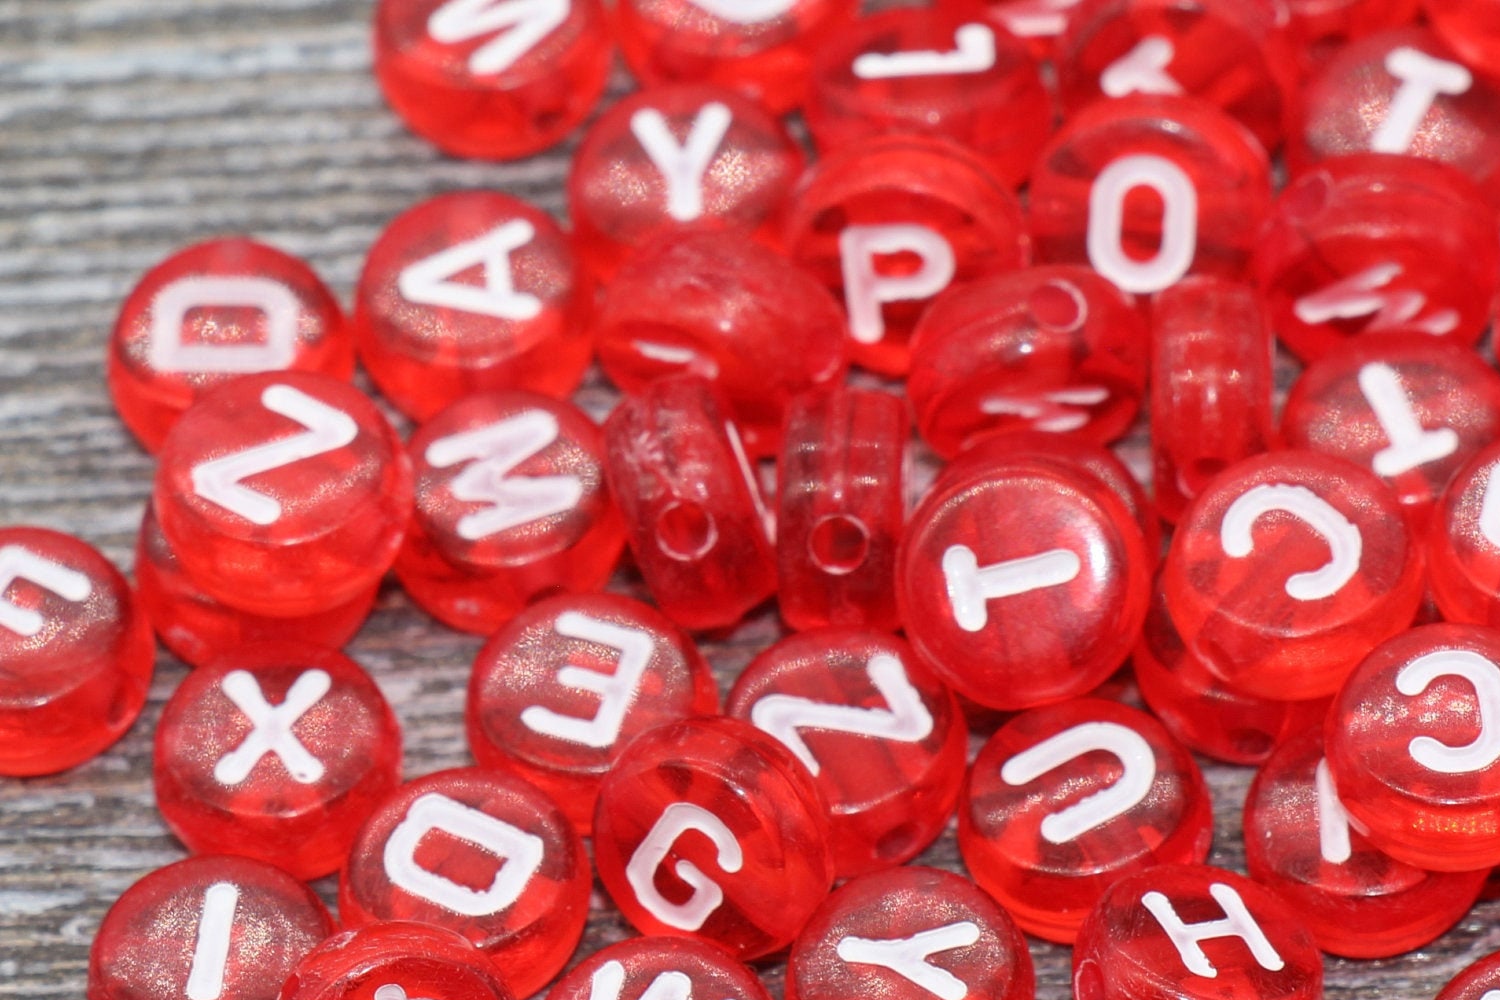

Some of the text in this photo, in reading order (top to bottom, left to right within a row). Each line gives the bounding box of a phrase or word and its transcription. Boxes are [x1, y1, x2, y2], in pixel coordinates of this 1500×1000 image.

[854, 24, 995, 79] L
[1361, 47, 1470, 155] T
[630, 102, 732, 223] Y
[396, 218, 544, 324] A
[1088, 155, 1197, 293] O
[140, 274, 303, 375] D
[841, 226, 954, 343] P
[189, 383, 359, 526] Z
[1358, 362, 1459, 477] T
[941, 544, 1082, 632] T
[1220, 483, 1363, 602] C
[213, 669, 331, 787] X
[520, 610, 657, 748] E
[1001, 722, 1156, 845] U
[383, 791, 545, 917] D
[626, 802, 743, 932] G
[1141, 883, 1284, 978] H
